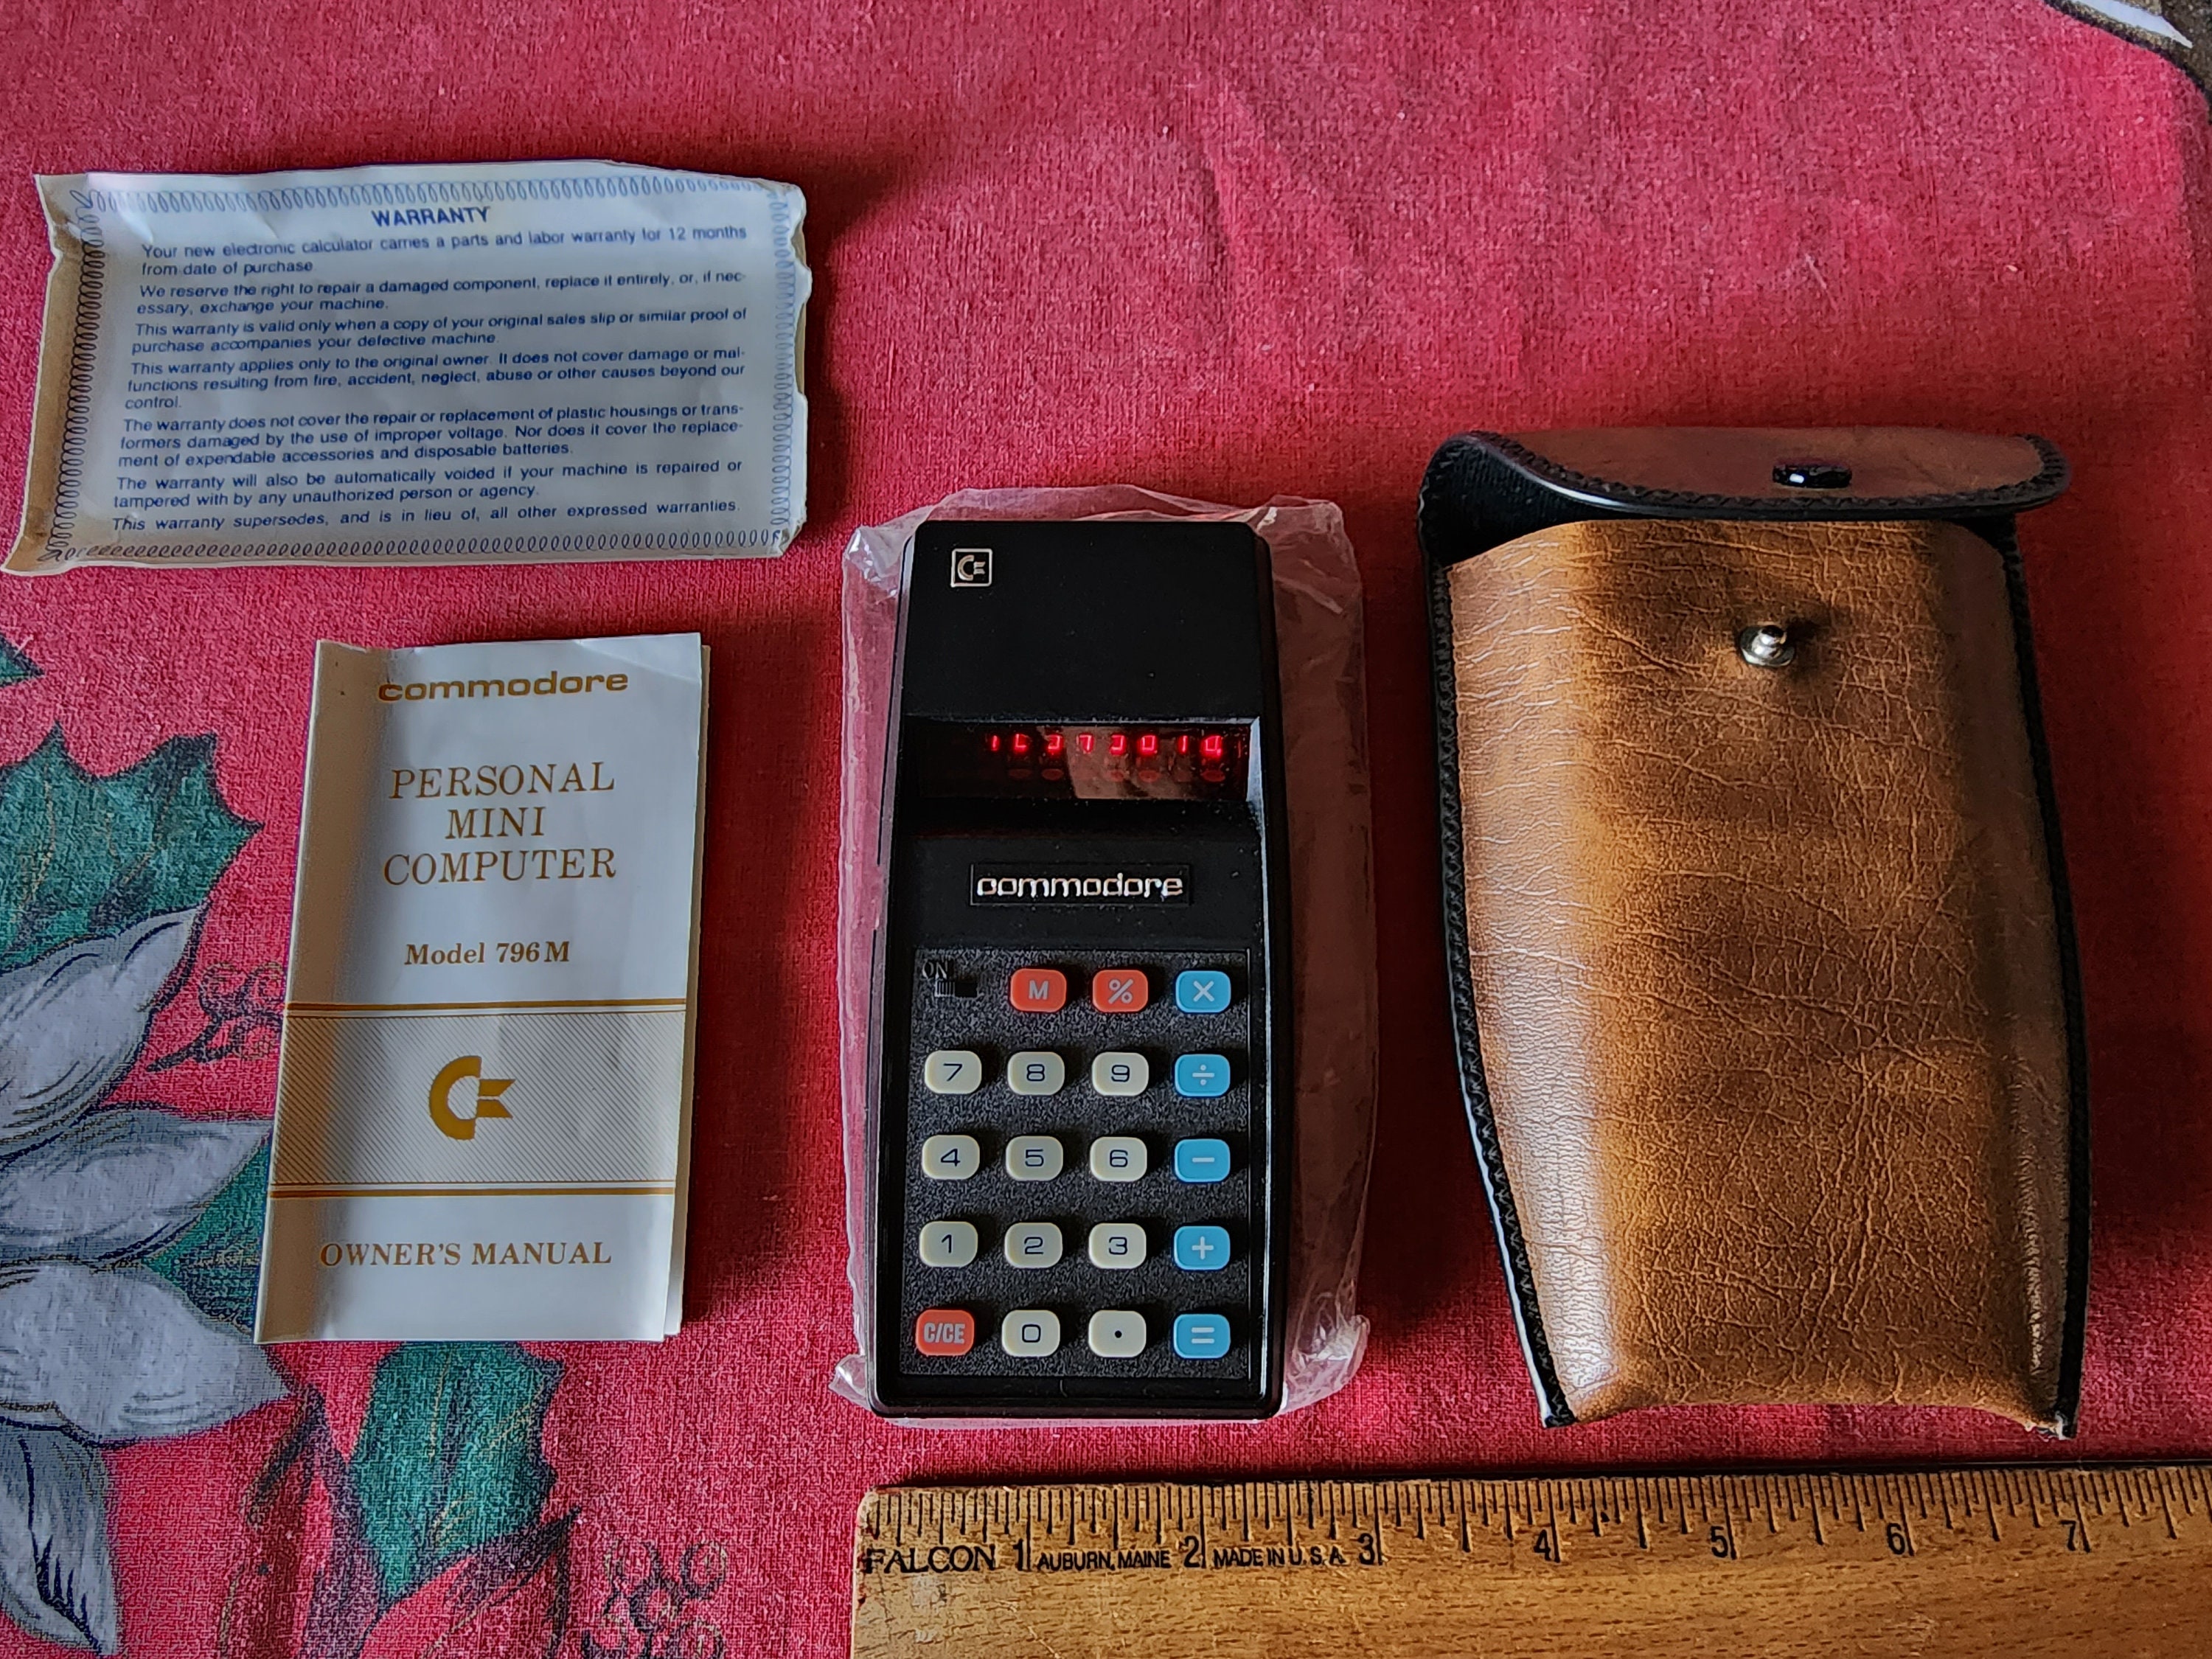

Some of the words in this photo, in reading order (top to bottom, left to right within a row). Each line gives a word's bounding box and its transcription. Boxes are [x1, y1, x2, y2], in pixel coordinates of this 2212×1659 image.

[371, 206, 488, 227] WARRANTY
[141, 242, 178, 258] Your
[184, 244, 216, 257] new
[222, 238, 296, 255] electronic
[301, 236, 373, 253] calculator
[451, 232, 490, 251] parts
[495, 231, 523, 246] and
[528, 230, 565, 246] labor
[571, 228, 636, 248] warranty
[641, 227, 661, 243] for
[669, 226, 686, 242] 12
[692, 225, 748, 241] months
[142, 260, 178, 276] from
[183, 259, 217, 274] date
[140, 282, 166, 298] We
[170, 284, 229, 297] reserve
[233, 280, 257, 296] the
[261, 279, 295, 299] right
[299, 279, 313, 294] to
[317, 278, 361, 297] repair
[378, 276, 449, 296] damaged
[545, 271, 600, 291] replace
[199, 297, 274, 316] exchange
[280, 299, 313, 315] your
[137, 320, 167, 335] This
[172, 319, 240, 338] warranty
[259, 317, 295, 333] valid
[298, 316, 331, 335] only
[335, 315, 376, 331] when
[393, 317, 430, 333] copy
[451, 316, 484, 332] your
[487, 311, 543, 331] original
[546, 310, 586, 325] sales
[590, 309, 616, 328] slip
[639, 307, 686, 322] similar
[689, 305, 729, 324] proof
[131, 335, 204, 356] purchase
[210, 333, 312, 354] accompanies
[318, 335, 351, 352] your
[357, 330, 426, 347] defective
[131, 359, 163, 375] This
[168, 358, 235, 378] warranty
[238, 356, 294, 376] applies
[298, 355, 331, 375] only
[355, 354, 379, 369] the
[383, 352, 439, 372] original
[512, 349, 549, 365] does
[554, 348, 578, 364] not
[581, 349, 624, 363] cover
[627, 345, 689, 365] damage
[128, 375, 198, 392] functions
[204, 373, 268, 393] resulting
[274, 372, 308, 387] from
[486, 366, 533, 382] abuse
[557, 364, 597, 380] other
[601, 365, 655, 378] causes
[660, 361, 717, 380] beyond
[720, 363, 745, 375] our
[124, 416, 153, 431] The
[156, 414, 226, 434] warranty
[228, 413, 266, 428] does
[270, 412, 295, 428] not
[298, 414, 341, 427] cover
[345, 410, 369, 425] the
[373, 408, 417, 428] repair
[439, 406, 535, 426] replacement
[556, 404, 605, 423] plastic
[610, 402, 678, 422] housings
[120, 432, 181, 449] formers
[187, 430, 260, 451] damaged
[291, 428, 314, 444] the
[320, 430, 348, 443] use
[375, 425, 442, 445] improper
[515, 422, 543, 437] Nor
[547, 421, 585, 437] does
[605, 422, 647, 435] cover
[653, 419, 676, 434] the
[118, 451, 159, 467] ment
[185, 448, 276, 468] expendable
[282, 445, 375, 462] accessories
[380, 444, 408, 459] and
[414, 442, 497, 462] disposable
[116, 474, 147, 490] The
[155, 472, 225, 493] warranty
[232, 471, 257, 487] will
[265, 470, 299, 486] also
[306, 470, 326, 484] be
[334, 467, 436, 487] automatically
[444, 465, 495, 481] voided
[520, 465, 554, 482] your
[562, 460, 627, 477] machine
[656, 456, 720, 477] repaired
[114, 491, 190, 512] tampered
[196, 490, 229, 506] with
[233, 490, 253, 508] by
[258, 491, 287, 507] any
[292, 484, 394, 503] unauthorized
[399, 486, 453, 503] person
[112, 515, 145, 530] This
[156, 512, 225, 532] warranty
[340, 508, 370, 524] and
[424, 505, 451, 521] lieu
[490, 504, 508, 519] all
[517, 502, 557, 518] other
[567, 499, 647, 520] expressed
[378, 670, 629, 702] commodore
[389, 761, 615, 800] PERSONAL
[445, 806, 546, 840] MINI
[383, 847, 616, 886] COMPUTER
[976, 872, 1183, 897] commodore
[404, 942, 485, 965] Model
[1029, 980, 1048, 1001] M
[943, 1062, 963, 1082] 7
[1026, 1063, 1046, 1082] 8
[1110, 1064, 1130, 1082] 9
[940, 1148, 961, 1167] 4
[1024, 1149, 1044, 1167] 5
[1109, 1149, 1129, 1168] 6
[320, 1242, 462, 1267] OWNER'S
[470, 1241, 613, 1265] MANUAL
[941, 1234, 953, 1253] 1
[1023, 1237, 1044, 1255] 2
[1108, 1237, 1128, 1255] 3
[923, 1322, 966, 1344] C/CE
[1021, 1324, 1041, 1343] 0
[1357, 1533, 1376, 1565] 3
[1533, 1528, 1551, 1562] 4
[1709, 1525, 1729, 1558] 5
[1886, 1522, 1906, 1555] 6
[2059, 1520, 2076, 1551] 7
[864, 1545, 996, 1574] FALCON
[1012, 1537, 1024, 1572] 1
[1118, 1550, 1173, 1570] MAINE
[1183, 1535, 1201, 1568] 2
[1213, 1548, 1265, 1568] MADE
[1267, 1546, 1286, 1566] IN
